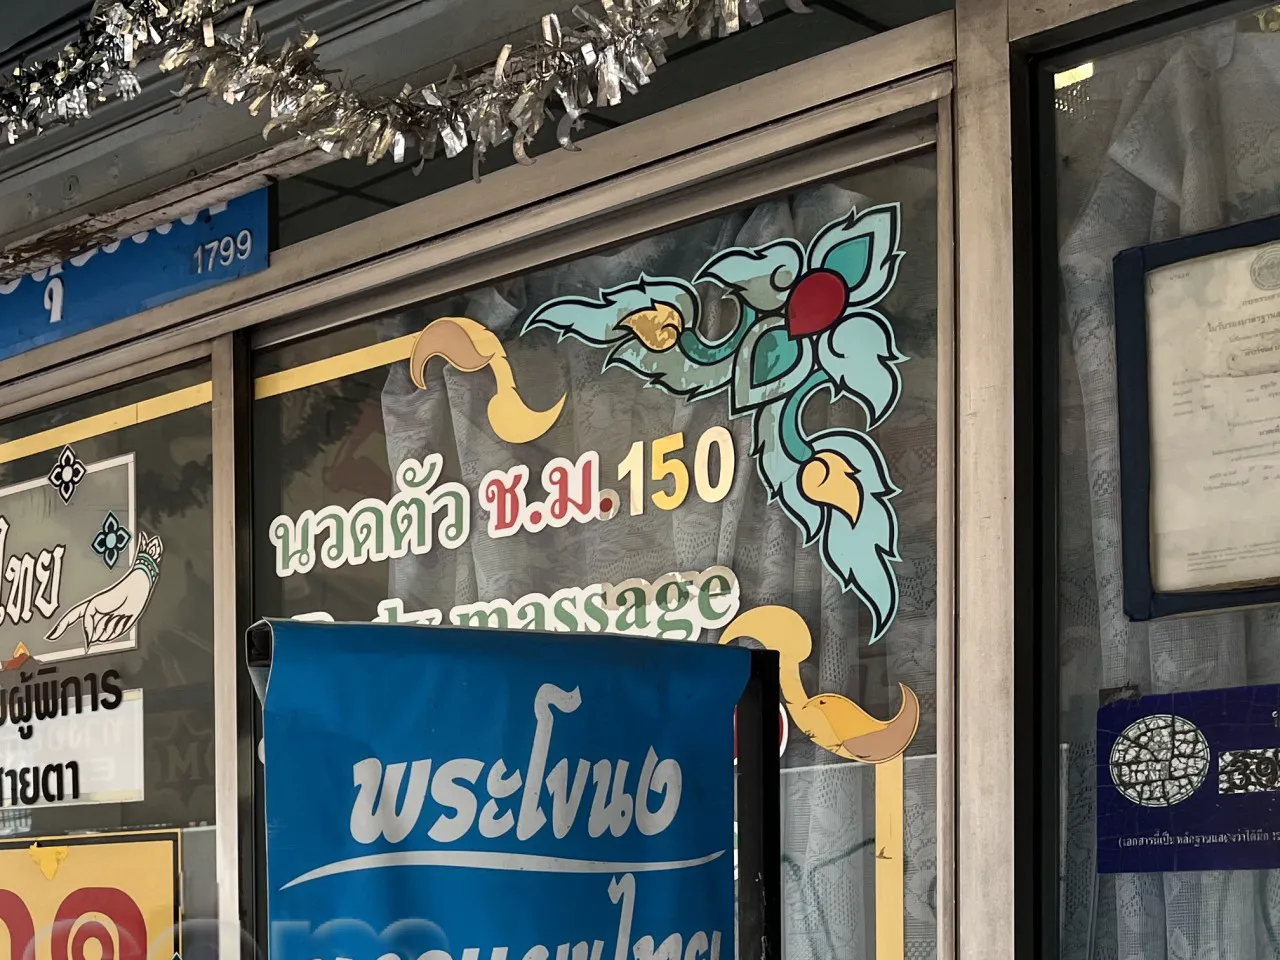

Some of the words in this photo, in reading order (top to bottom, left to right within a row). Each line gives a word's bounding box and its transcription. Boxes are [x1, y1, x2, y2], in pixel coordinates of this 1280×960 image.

[193, 229, 252, 274] 1799
[269, 453, 471, 578] นวดตัว
[348, 682, 684, 845] พระโขนง
